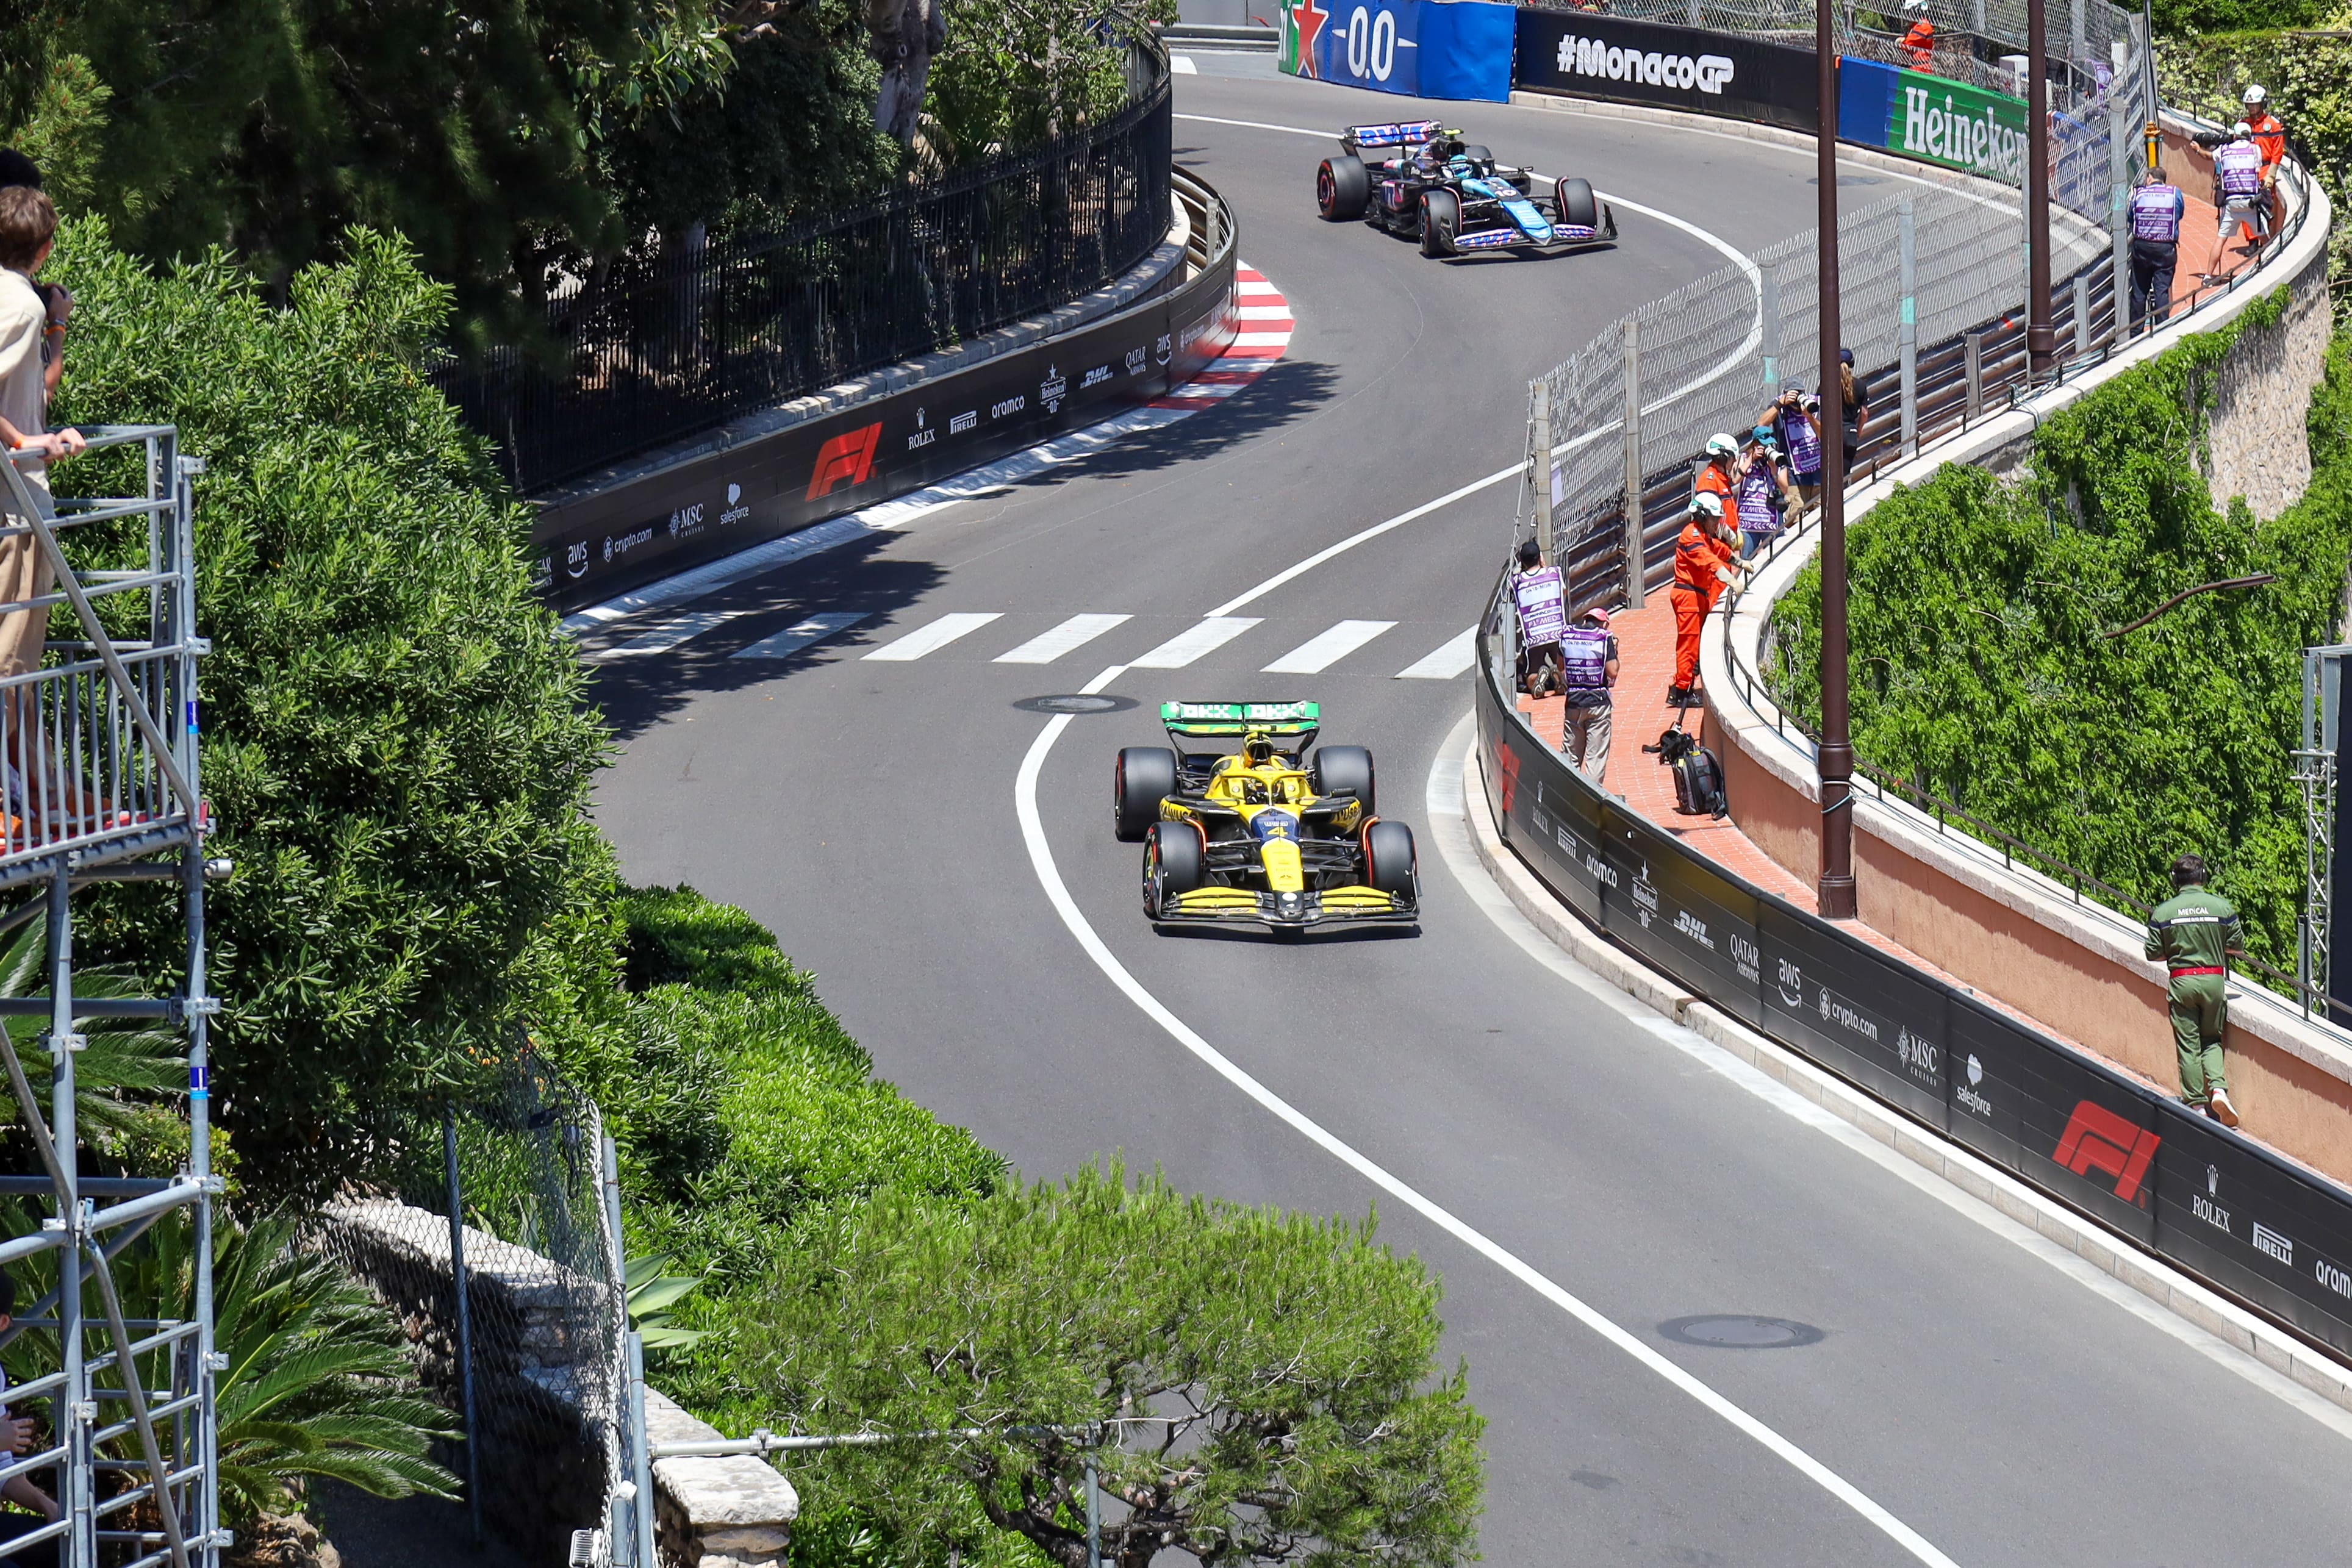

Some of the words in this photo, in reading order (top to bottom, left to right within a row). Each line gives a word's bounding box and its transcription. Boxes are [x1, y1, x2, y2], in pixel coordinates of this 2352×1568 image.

[1557, 34, 1735, 95] #MonacoGP
[1494, 189, 1517, 198] 10
[1156, 333, 1171, 354] aws
[1125, 346, 1146, 369] QATAR
[1081, 365, 1111, 388] DHL
[1041, 382, 1065, 399] Heineken
[991, 395, 1025, 419] aramco
[950, 410, 977, 435] PIRELLI
[908, 428, 935, 450] ROLEX
[680, 503, 704, 529] MSC
[720, 506, 750, 524] salesforce
[567, 540, 588, 565] aws
[614, 528, 653, 553] crypto.com
[1182, 704, 1230, 718] OKX
[1250, 704, 1299, 718] OKX
[1267, 826, 1288, 837] 4
[1557, 825, 1577, 859] PIRELLI
[1586, 853, 1618, 889] aramco
[1633, 882, 1657, 911] Heineken
[2177, 906, 2209, 915] MEDICAL
[1676, 910, 1712, 947] DHL
[1730, 934, 1760, 969] QATAR
[1737, 961, 1760, 986] AIRWAYS
[1778, 957, 1801, 990] aws
[1831, 1002, 1878, 1041] crypto.com
[1910, 1035, 1938, 1073] MSC
[1910, 1065, 1938, 1087] CRUISES
[1956, 1084, 1992, 1117] salesforce
[2052, 1100, 2161, 1203] F1
[2192, 1194, 2231, 1233] ROLEX
[2251, 1221, 2293, 1267] PIRELLI
[2315, 1259, 2352, 1300] aram
